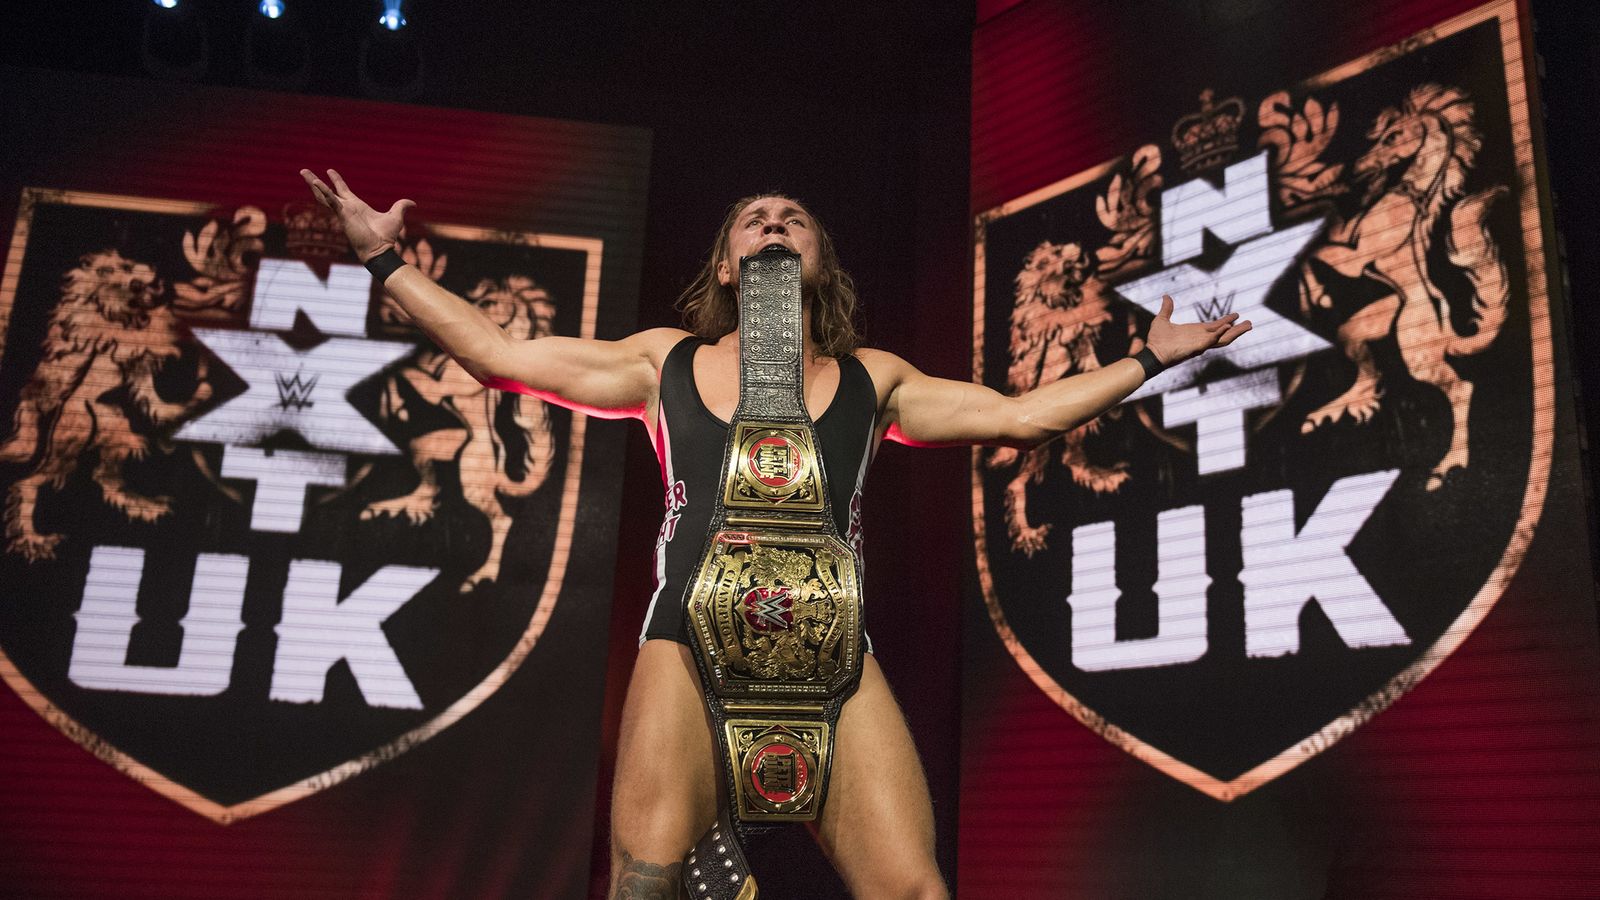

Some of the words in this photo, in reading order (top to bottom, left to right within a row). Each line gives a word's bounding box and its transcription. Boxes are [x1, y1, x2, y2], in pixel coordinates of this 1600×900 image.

[171, 258, 416, 533] NXT
[760, 444, 775, 479] DUNNE
[774, 448, 787, 475] PETE
[717, 569, 737, 649] CHAMPION
[821, 569, 844, 607] UNITED
[1066, 469, 1412, 672] UK
[69, 546, 441, 710] UK
